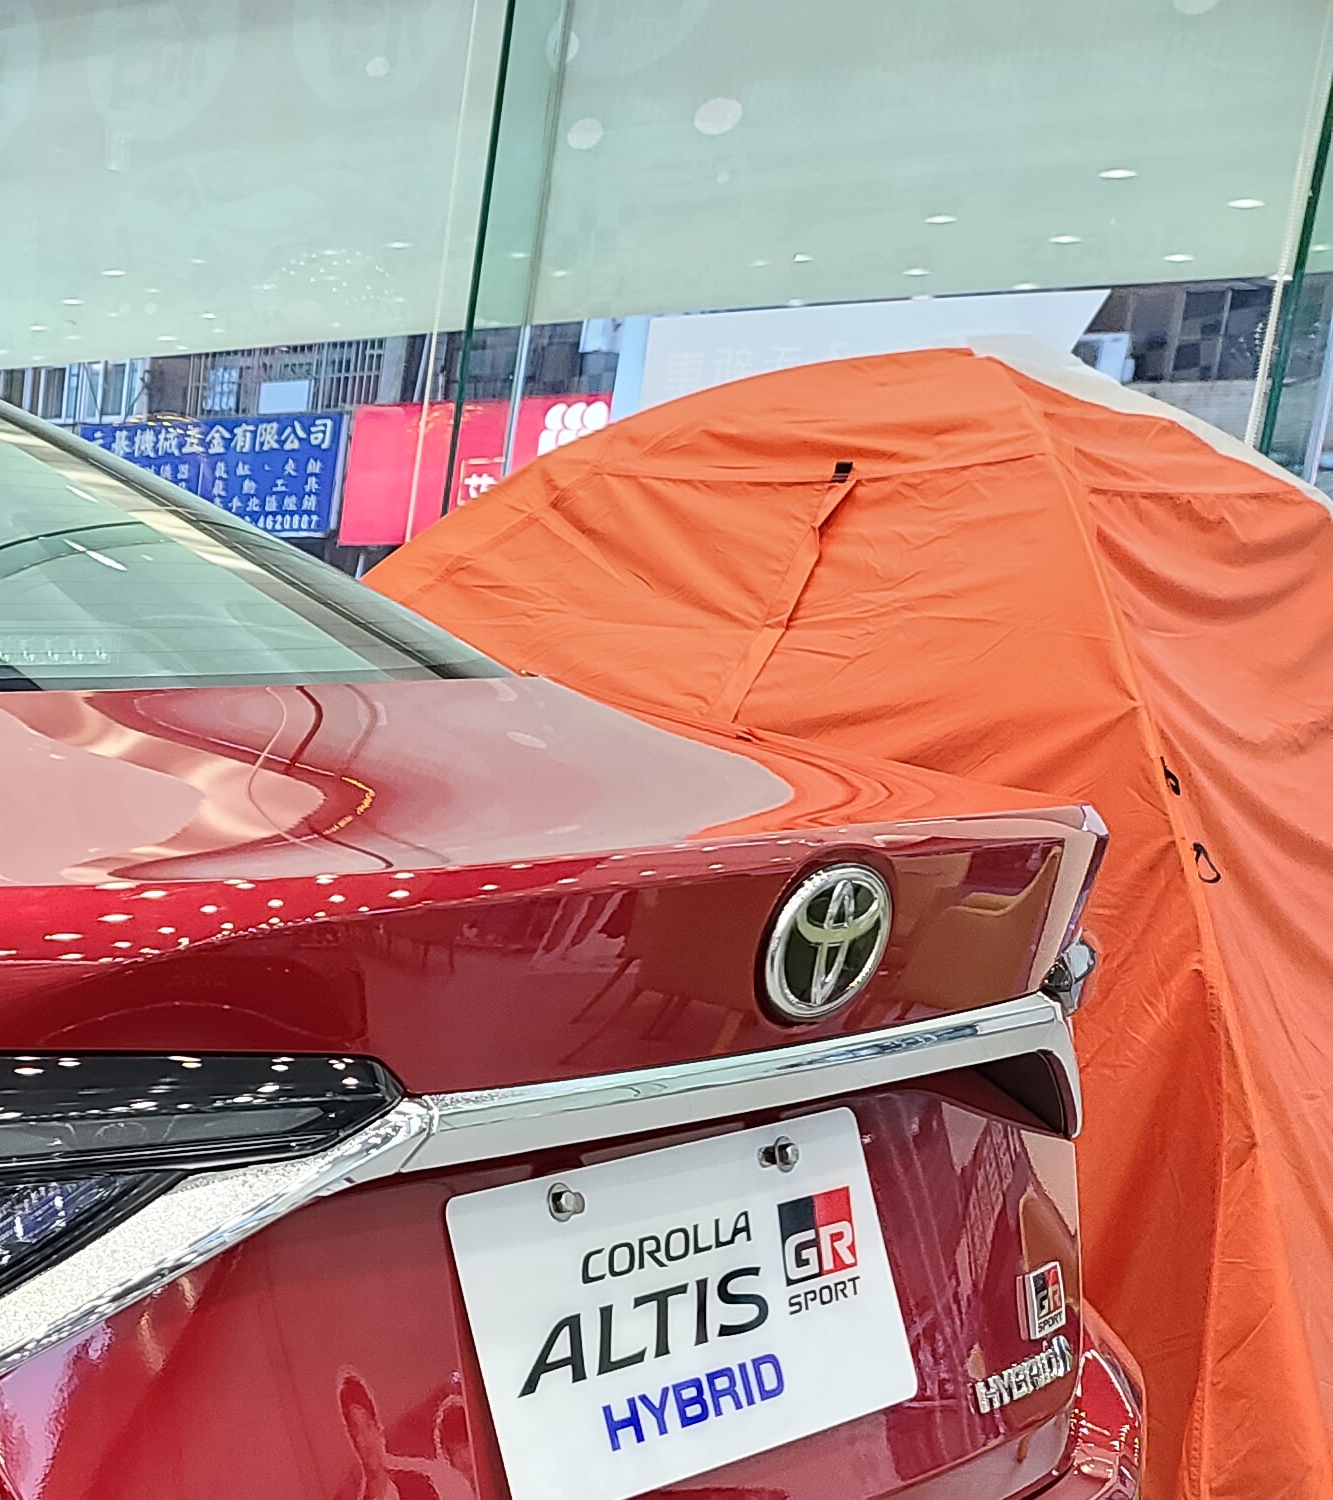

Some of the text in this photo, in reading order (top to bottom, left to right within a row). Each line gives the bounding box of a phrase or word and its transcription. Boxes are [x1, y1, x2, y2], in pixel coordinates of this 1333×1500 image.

[582, 1210, 752, 1284] COROLLA
[784, 1220, 856, 1282] GR
[788, 1276, 860, 1315] SPORT
[1037, 1311, 1063, 1333] SPORT
[517, 1266, 769, 1399] ALTIS
[601, 1353, 784, 1451] HYBRID
